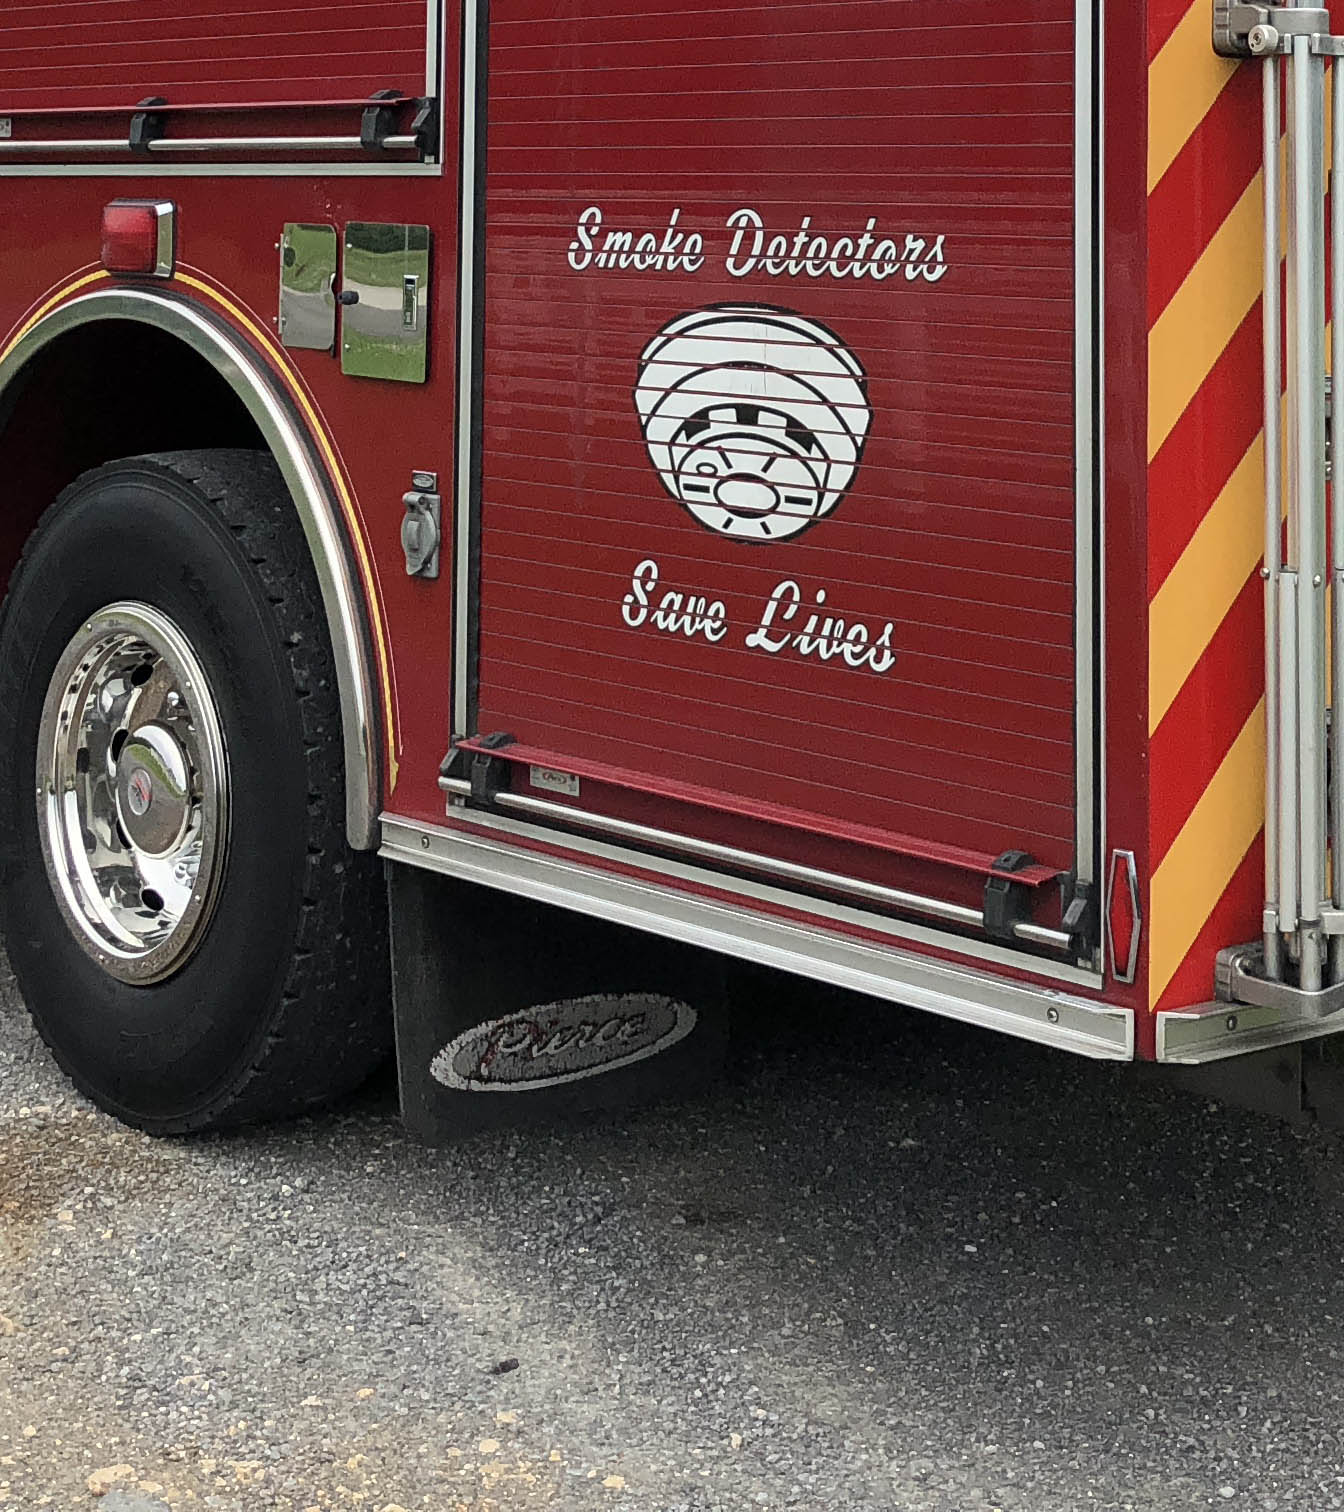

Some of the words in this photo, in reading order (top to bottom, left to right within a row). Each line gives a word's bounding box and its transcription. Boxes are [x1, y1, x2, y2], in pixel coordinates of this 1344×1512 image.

[567, 206, 705, 272] Smoke
[725, 208, 948, 282] Detectors
[622, 559, 728, 641] Save
[745, 580, 896, 672] Lives
